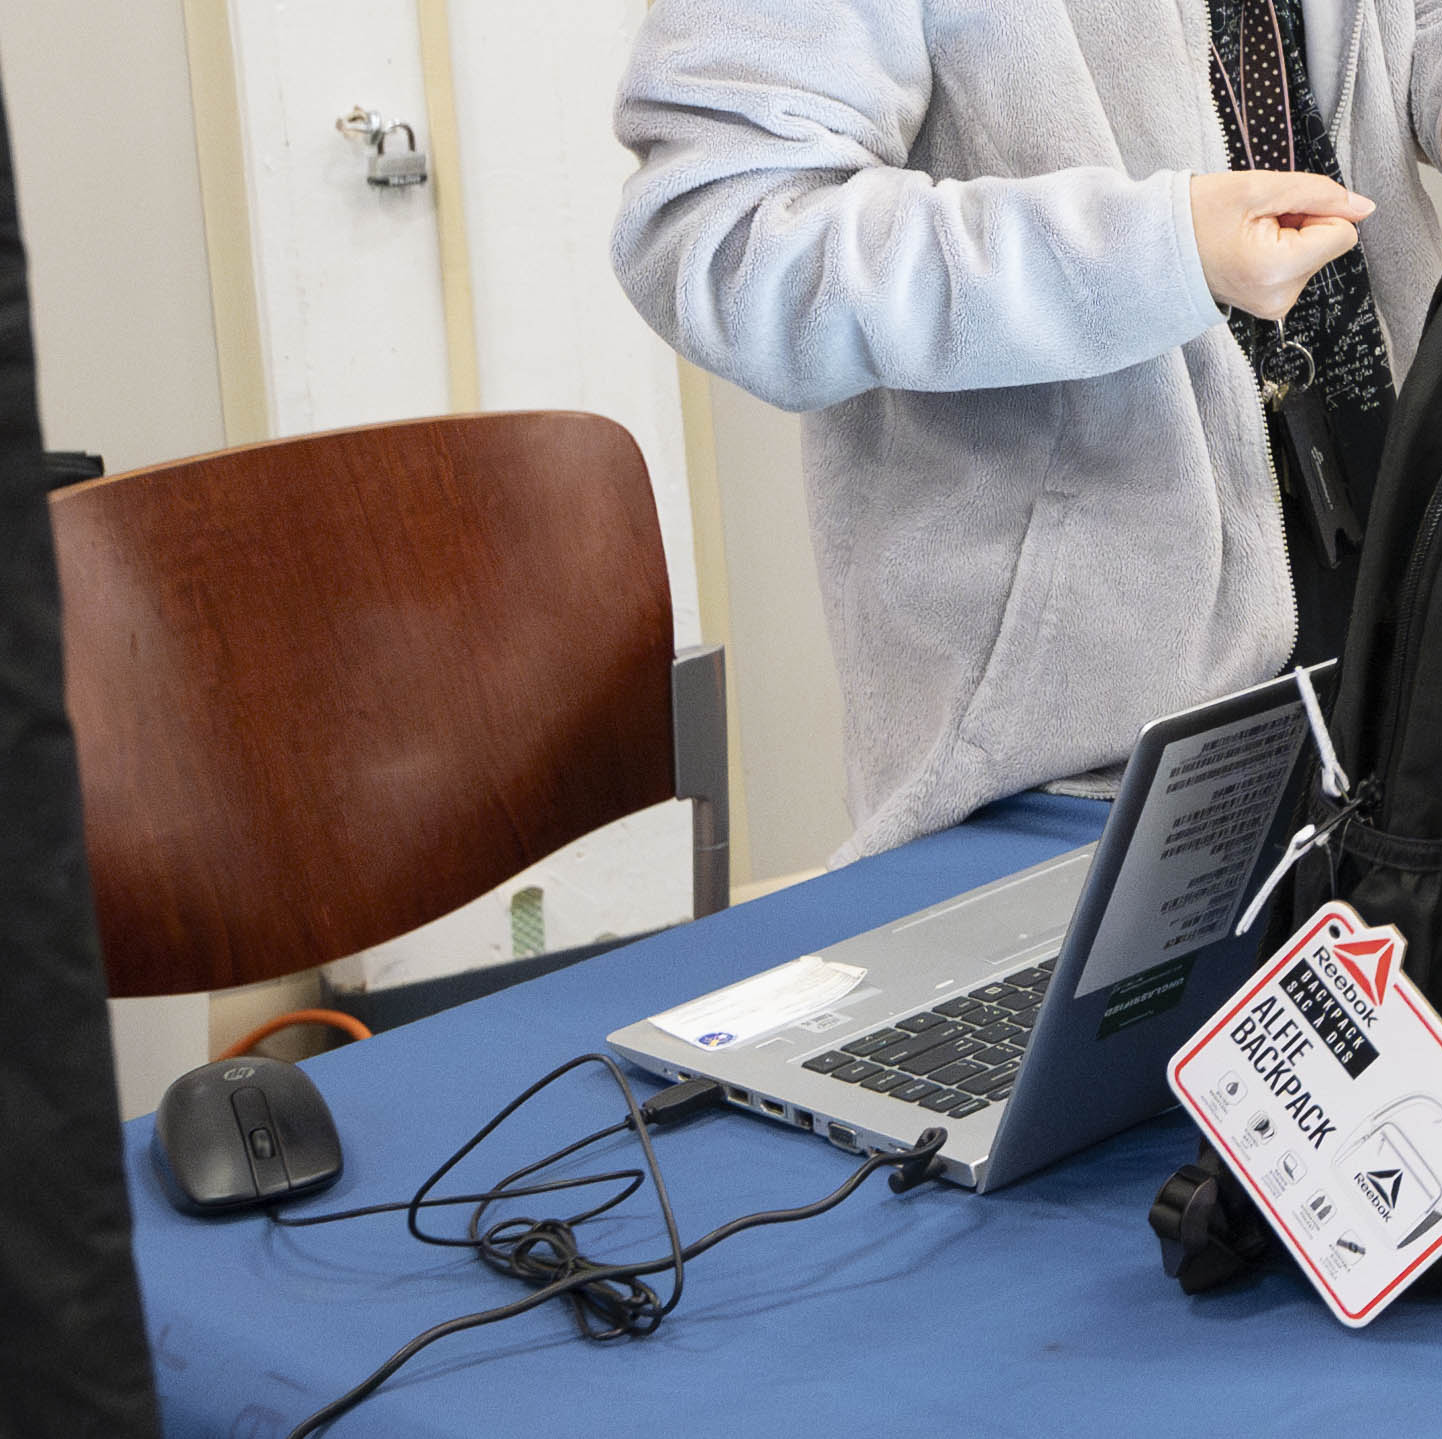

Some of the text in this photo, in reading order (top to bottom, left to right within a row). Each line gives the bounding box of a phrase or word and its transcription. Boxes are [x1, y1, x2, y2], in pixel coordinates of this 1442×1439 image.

[1103, 976, 1186, 1018] UNCLASSIFIED
[1285, 980, 1311, 1014] SAC
[1325, 1030, 1355, 1065] DOS
[1300, 969, 1364, 1051] BACKPACK
[1312, 945, 1379, 1029] Reebok
[1250, 994, 1316, 1068] ALFIE
[1229, 1015, 1338, 1150] BACKPACK
[1353, 1171, 1393, 1223] Reebok
